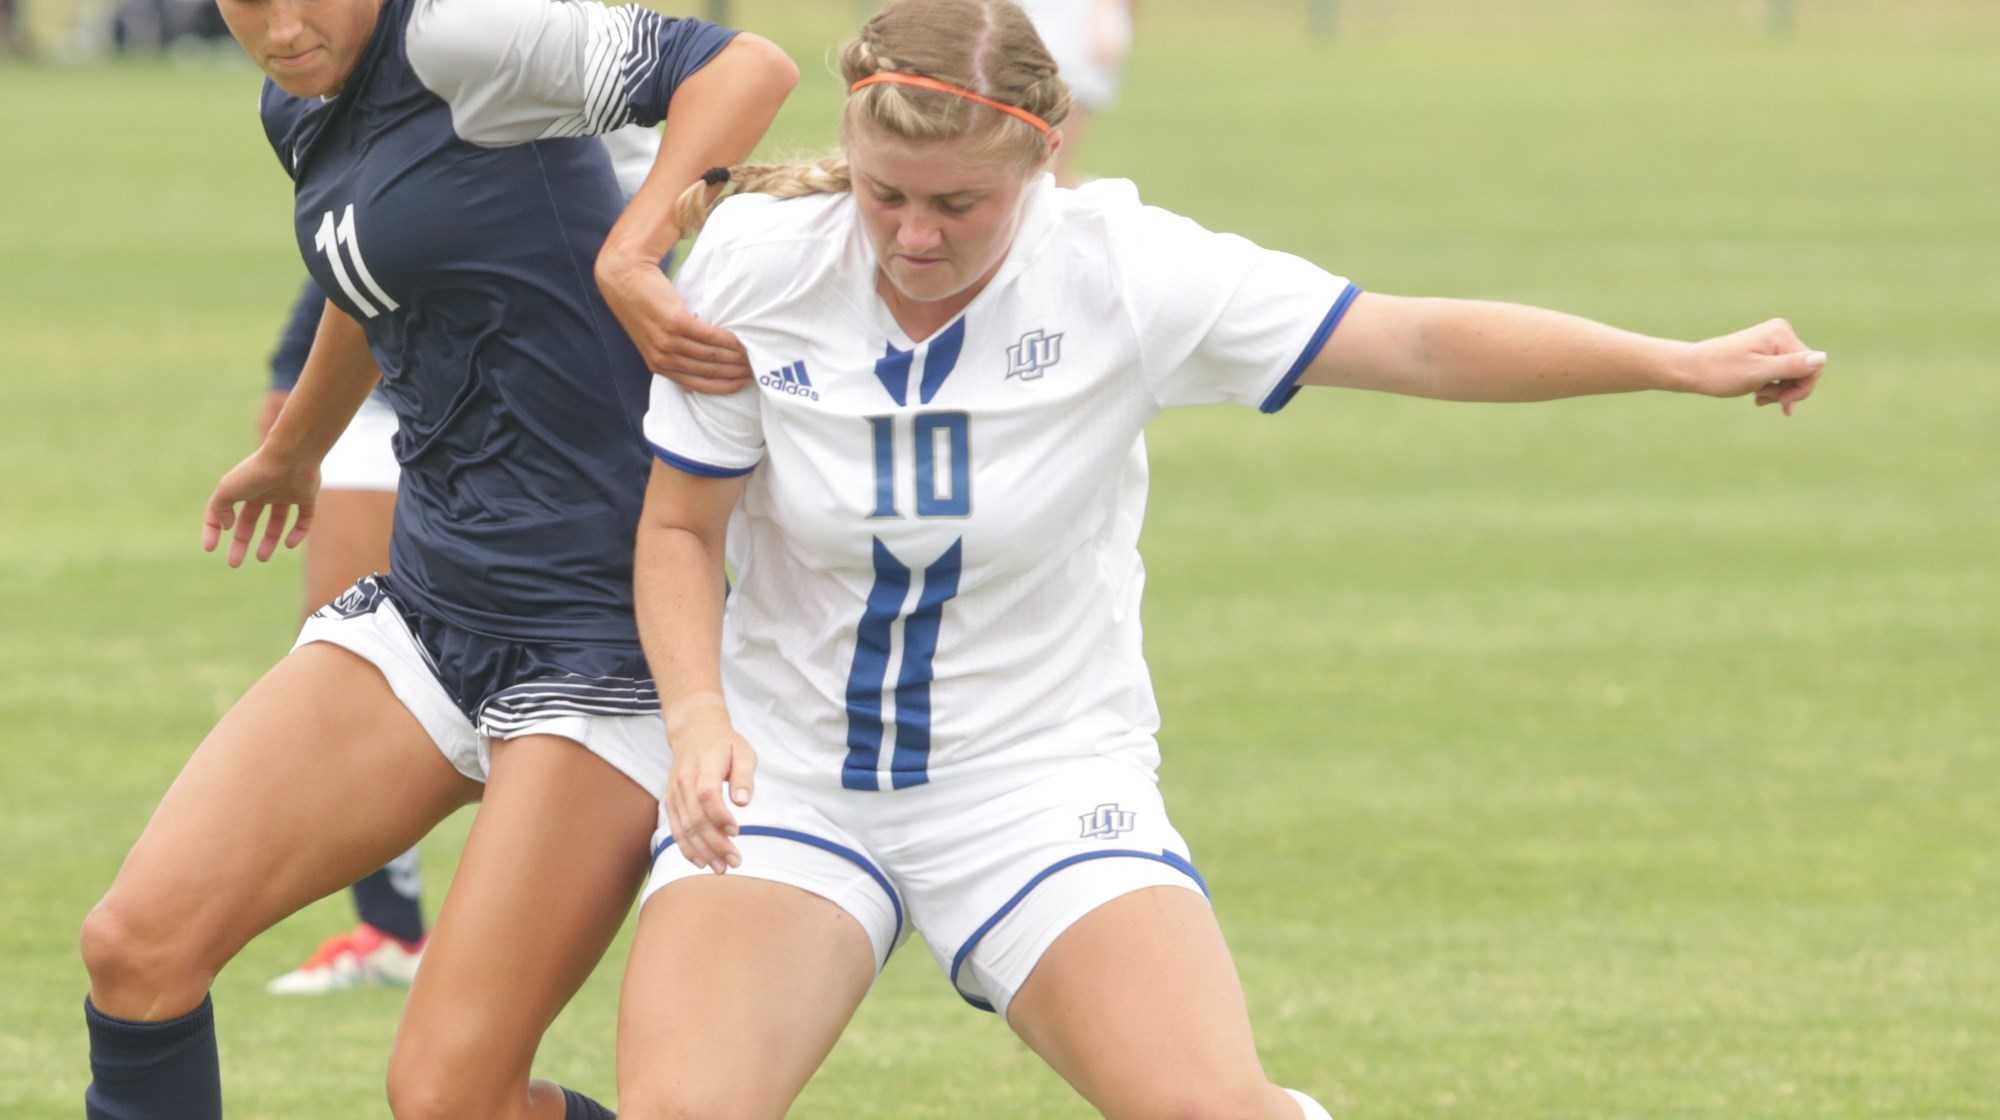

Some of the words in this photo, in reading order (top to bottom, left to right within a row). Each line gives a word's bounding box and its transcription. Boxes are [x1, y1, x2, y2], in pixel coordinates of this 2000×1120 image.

[314, 203, 400, 318] 11
[759, 375, 819, 402] adidas
[862, 410, 974, 520] 10
